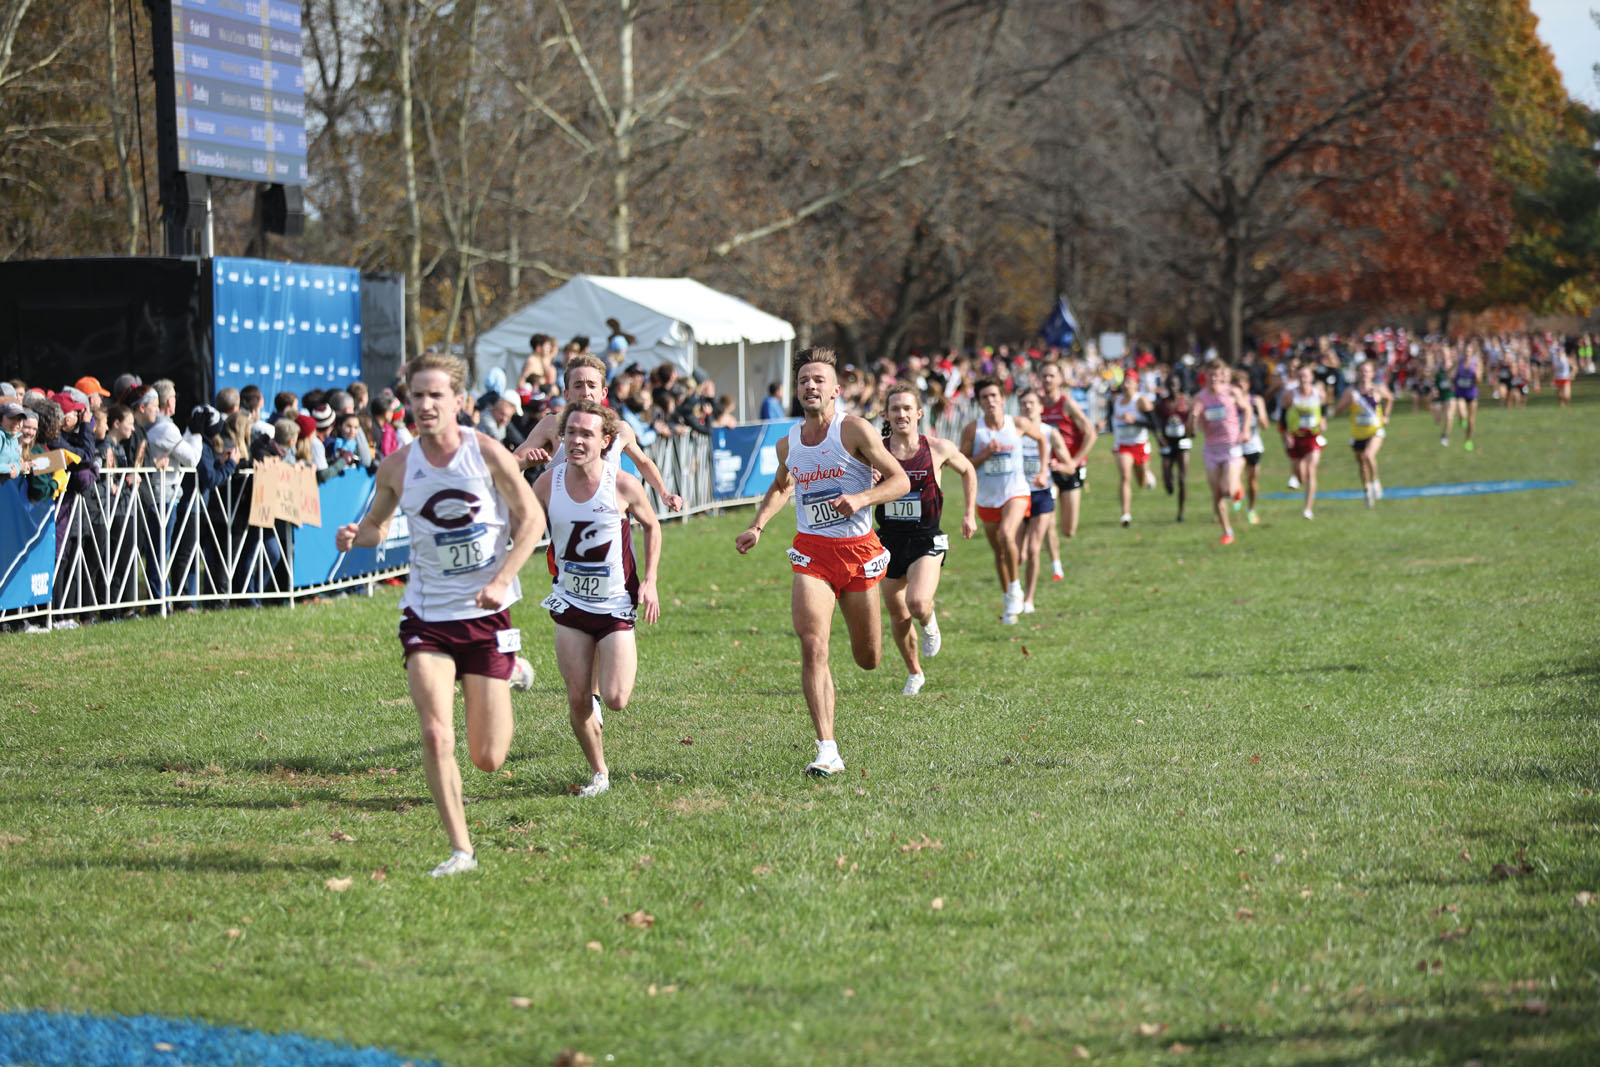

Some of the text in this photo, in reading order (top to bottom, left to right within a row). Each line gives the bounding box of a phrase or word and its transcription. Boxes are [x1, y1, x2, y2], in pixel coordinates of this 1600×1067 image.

[792, 464, 845, 491] Sagehens
[892, 502, 914, 517] 170
[449, 541, 483, 567] 278
[572, 576, 600, 596] 342
